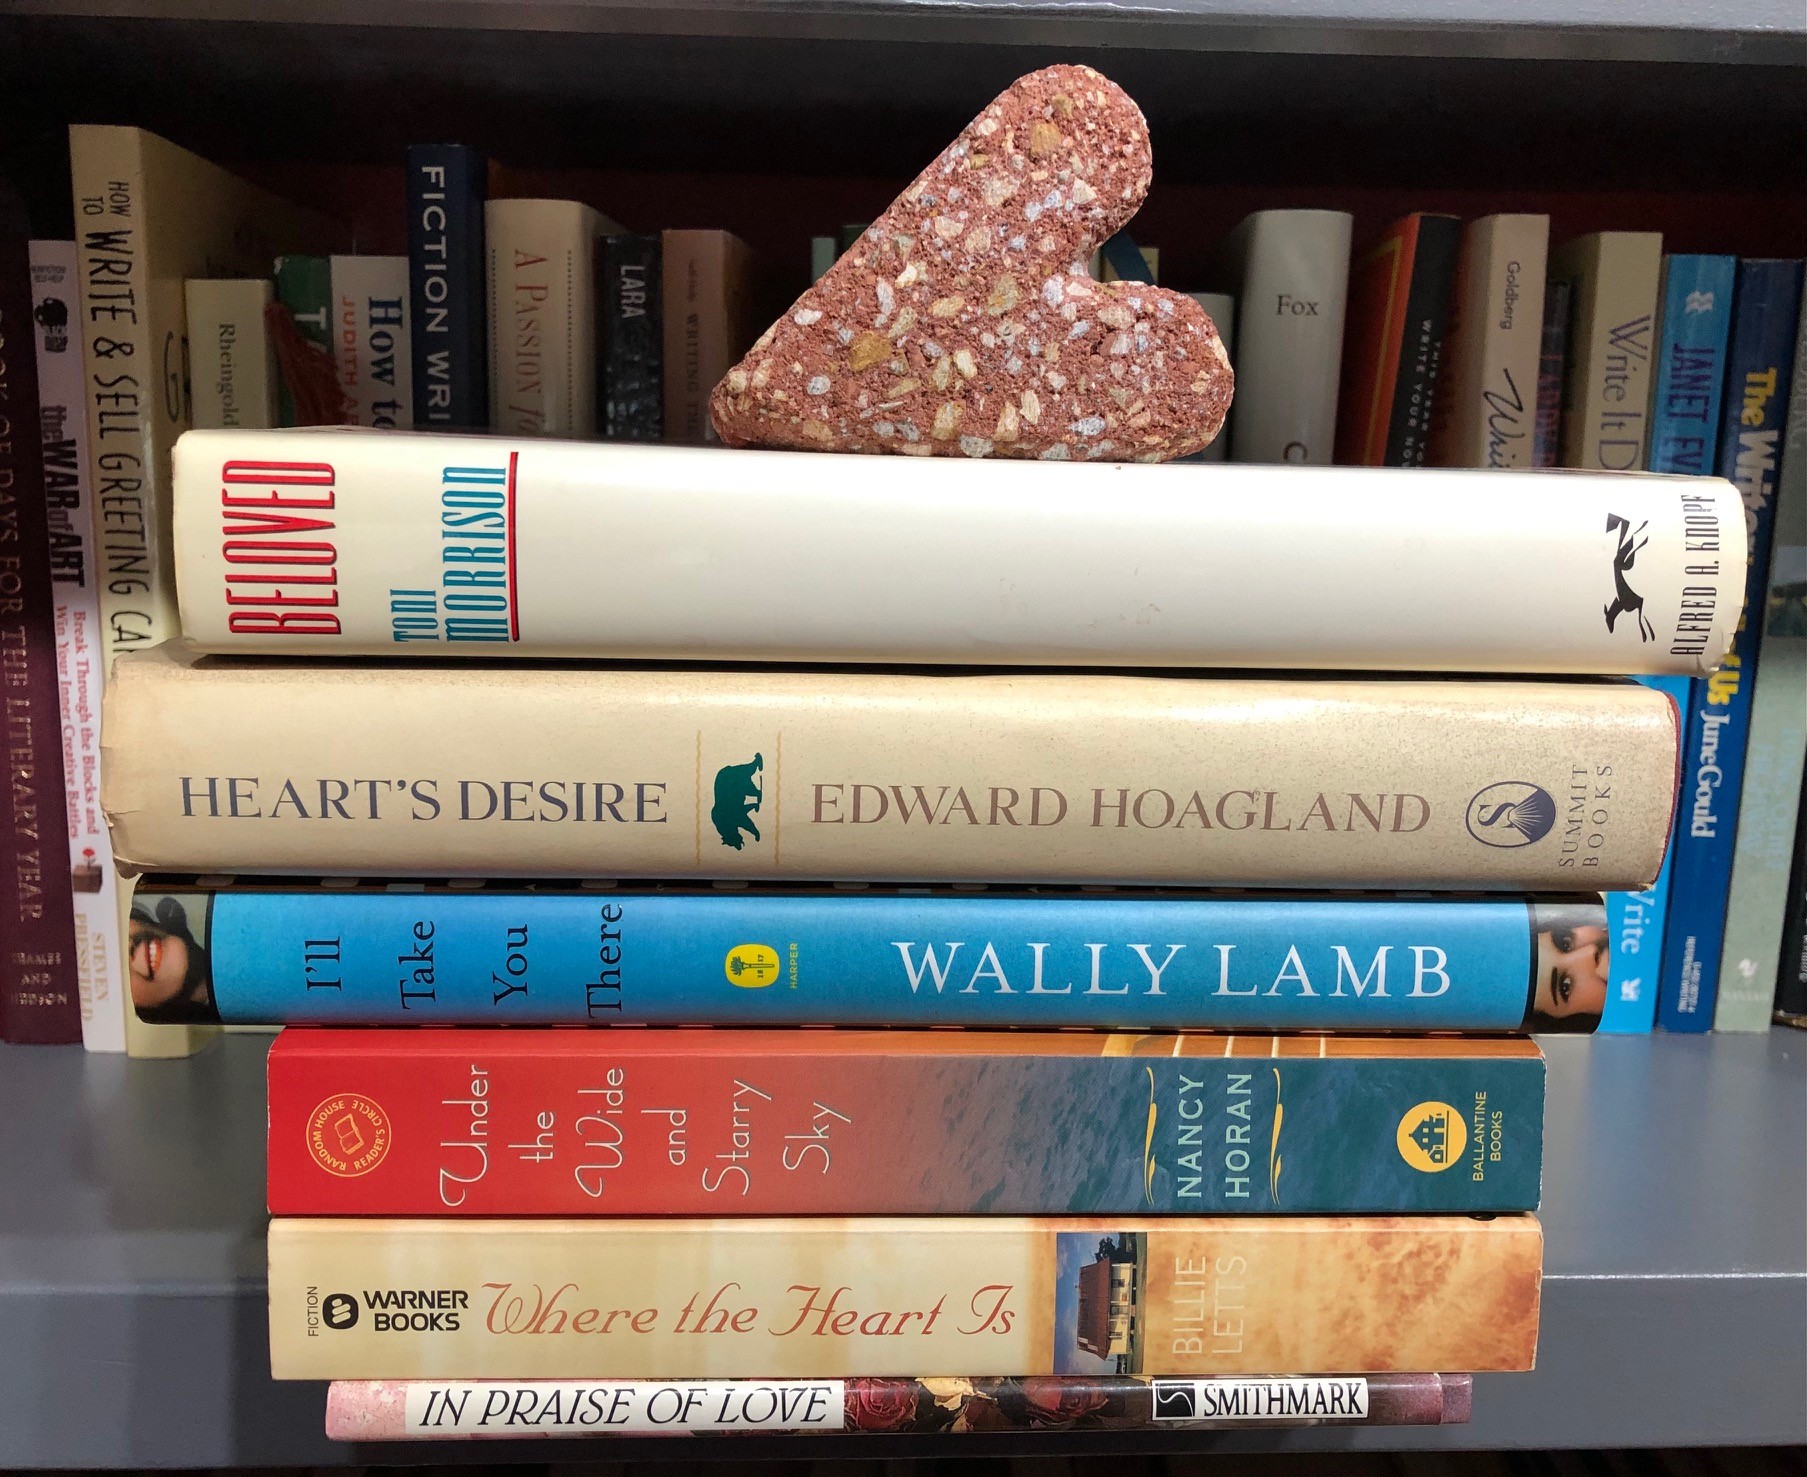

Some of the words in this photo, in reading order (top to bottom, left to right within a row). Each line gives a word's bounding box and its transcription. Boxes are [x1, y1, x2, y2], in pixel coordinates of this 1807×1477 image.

[81, 195, 104, 216] TO
[108, 181, 131, 217] HOW
[84, 230, 137, 325] WRITE
[420, 165, 449, 333] FICTION
[514, 248, 547, 269] A
[620, 264, 647, 320] LARA
[1276, 294, 1320, 318] Fox
[1500, 261, 1522, 331] Goldberg
[92, 337, 135, 359] &
[341, 296, 359, 386] JUDITH
[368, 297, 404, 387] How
[515, 283, 549, 394] PASSION
[1415, 319, 1433, 374] WRITE
[1602, 315, 1651, 402] Write
[219, 323, 240, 428] Rheingold
[1667, 342, 1716, 423] JANET
[1741, 366, 1777, 427] The
[93, 374, 140, 440] SELL
[1601, 411, 1642, 432] It
[98, 453, 151, 596] GREETING
[222, 460, 341, 635] BELOVED
[1680, 494, 1720, 552] KNOPF
[441, 466, 509, 642] MORRISON
[1684, 560, 1720, 576] A.
[0, 556, 23, 615] FOR
[390, 588, 440, 642] TONI
[56, 605, 68, 637] Win
[73, 611, 88, 654] Break
[110, 610, 152, 654] CA
[1670, 586, 1718, 655] ALFRED
[2, 625, 29, 687] THE
[58, 641, 69, 675] Your
[60, 680, 72, 721] Inner
[77, 658, 92, 723] Through
[1706, 666, 1740, 706] Us
[63, 724, 76, 785] Creative
[81, 727, 94, 750] the
[6, 697, 40, 840] LITERARY
[83, 755, 97, 803] Blocks
[67, 789, 80, 839] Battles
[86, 806, 99, 835] and
[458, 780, 667, 823] DESIRE
[811, 781, 1066, 828] EDWARD
[1089, 786, 1429, 833] HOAGLAND
[1558, 764, 1588, 868] SUMMIT
[1581, 764, 1612, 868] BOOKS
[16, 849, 43, 922] YEAR
[92, 931, 109, 1001] STEVEN
[399, 919, 436, 1010] Take
[493, 923, 529, 1006] You
[586, 902, 624, 1019] There
[789, 942, 798, 989] HARPER
[891, 940, 1187, 996] WALLY
[1211, 944, 1451, 998] LAMB
[314, 1100, 346, 1129] HOUSE
[350, 1099, 383, 1127] CIRCLE
[440, 1065, 489, 1208] Under
[508, 1111, 555, 1164] the
[575, 1066, 625, 1198] Wide
[640, 1106, 687, 1166] and
[701, 1079, 773, 1196] Starry
[783, 1101, 852, 1175] Sky
[1177, 1074, 1204, 1199] NANCY
[1225, 1073, 1252, 1199] HORAN
[1472, 1090, 1487, 1183] BALLANTINE
[1489, 1109, 1504, 1163] BOOKS
[312, 1131, 347, 1171] RANDOM
[307, 1285, 320, 1338] FICTION
[362, 1289, 470, 1310] WARNER
[373, 1311, 461, 1332] BOOKS
[480, 1282, 660, 1335] Where
[672, 1282, 758, 1335] the
[767, 1283, 948, 1337] Heart
[955, 1283, 1015, 1337] Is
[1172, 1256, 1206, 1355] BILLIE
[1211, 1255, 1248, 1355] LETTS
[419, 1389, 473, 1427] IN
[477, 1388, 637, 1426] PRAISE
[646, 1387, 709, 1424] OF
[715, 1386, 832, 1424] LOVE
[1203, 1382, 1364, 1418] SMITHMARK
